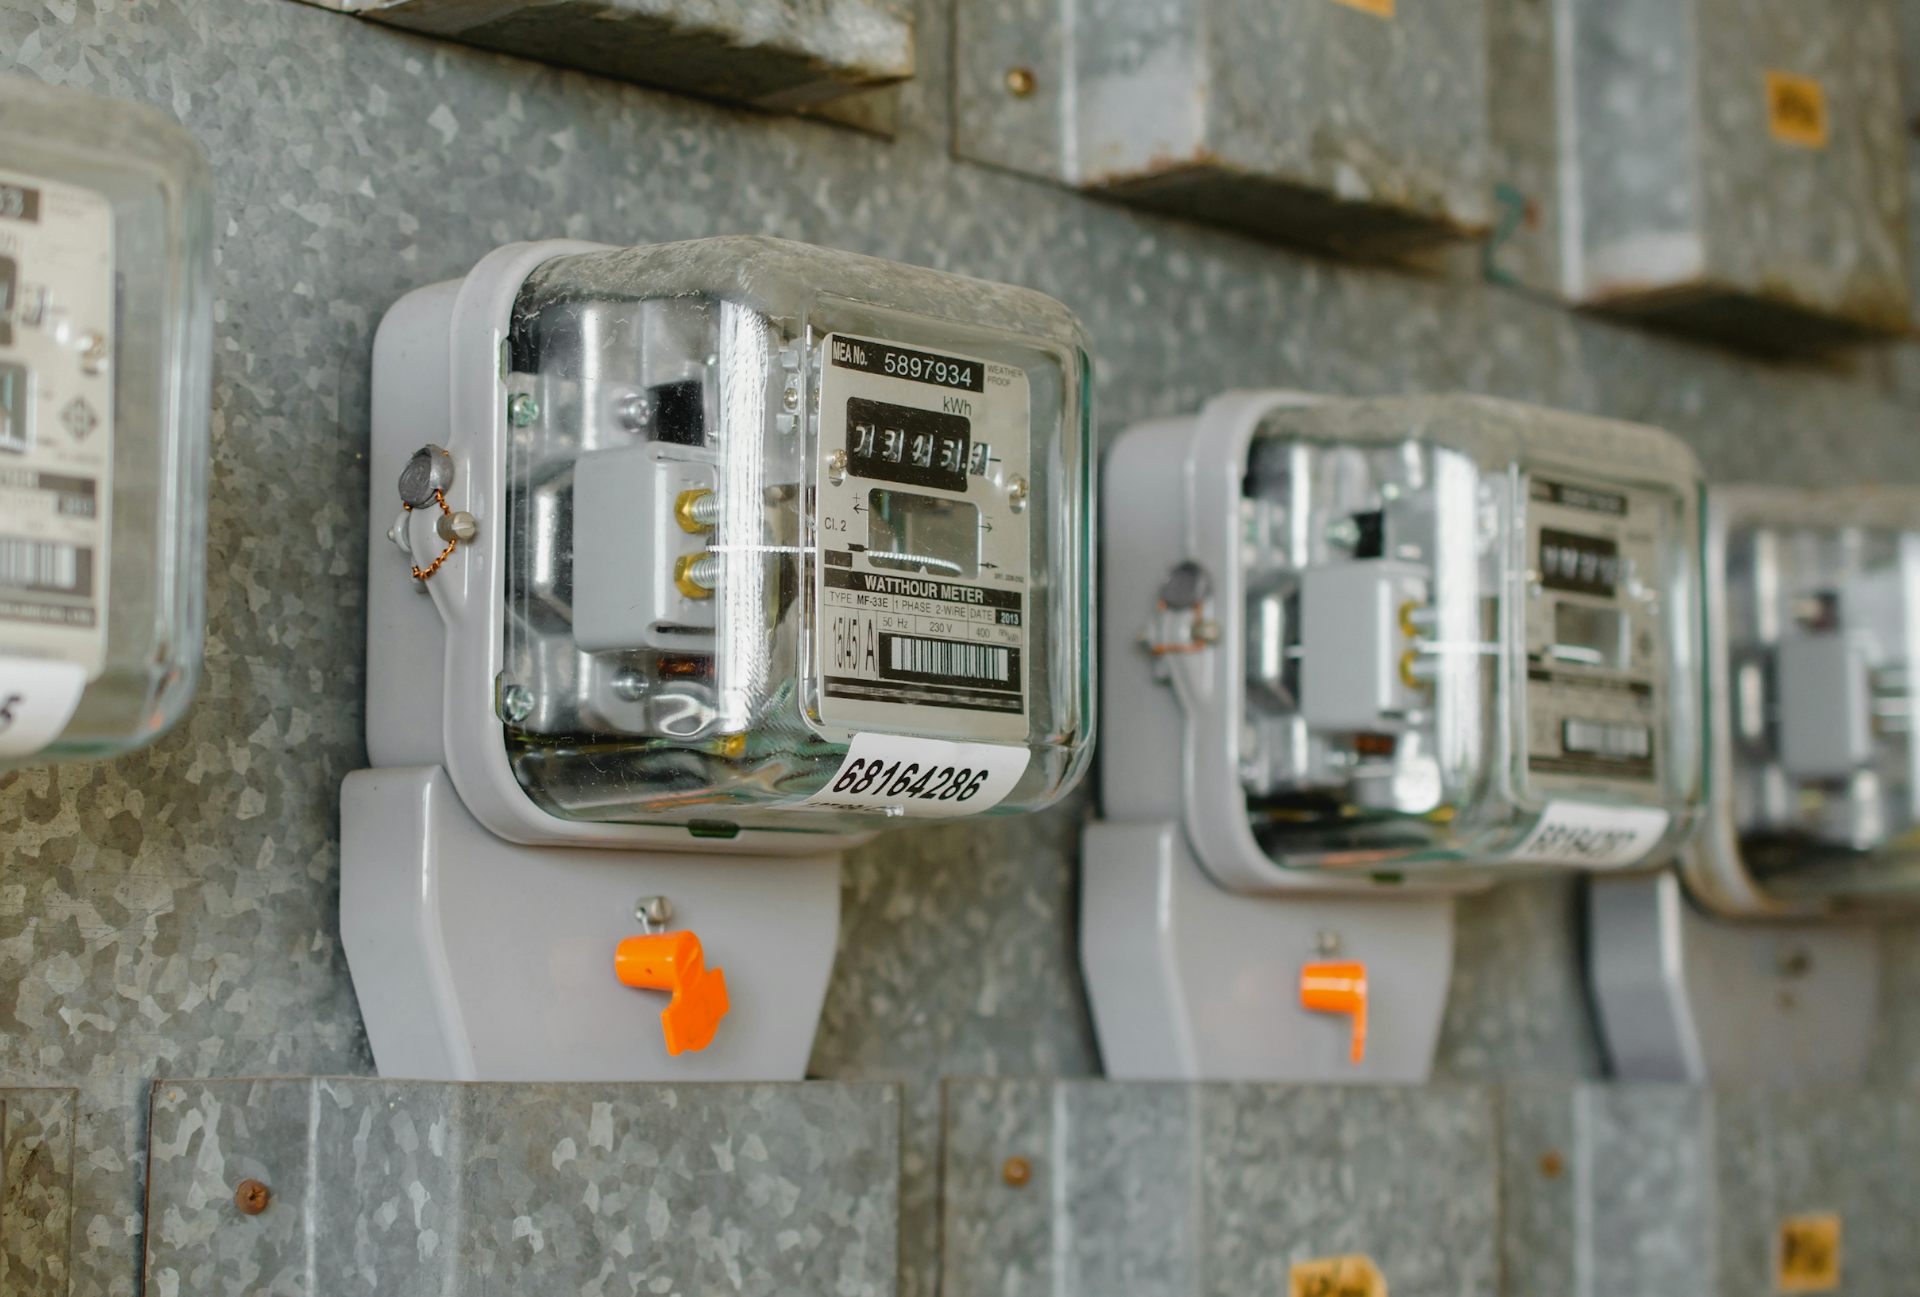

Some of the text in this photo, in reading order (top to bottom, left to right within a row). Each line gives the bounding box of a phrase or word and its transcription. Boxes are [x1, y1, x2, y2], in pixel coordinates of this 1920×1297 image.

[833, 341, 850, 362] MEA
[884, 353, 972, 387] 5897934
[943, 396, 971, 415] kWh
[841, 521, 847, 532] 2
[865, 574, 984, 604] WATTHOUR METER
[830, 591, 888, 607] TYPE MF-33E
[902, 600, 931, 613] PHASE
[935, 604, 966, 617] 2-WIRE
[970, 608, 1019, 625] DATE 2013
[882, 616, 908, 629] 50 Hz
[929, 621, 953, 633] 230 V
[866, 618, 876, 672] A
[833, 758, 989, 801] 68164286
